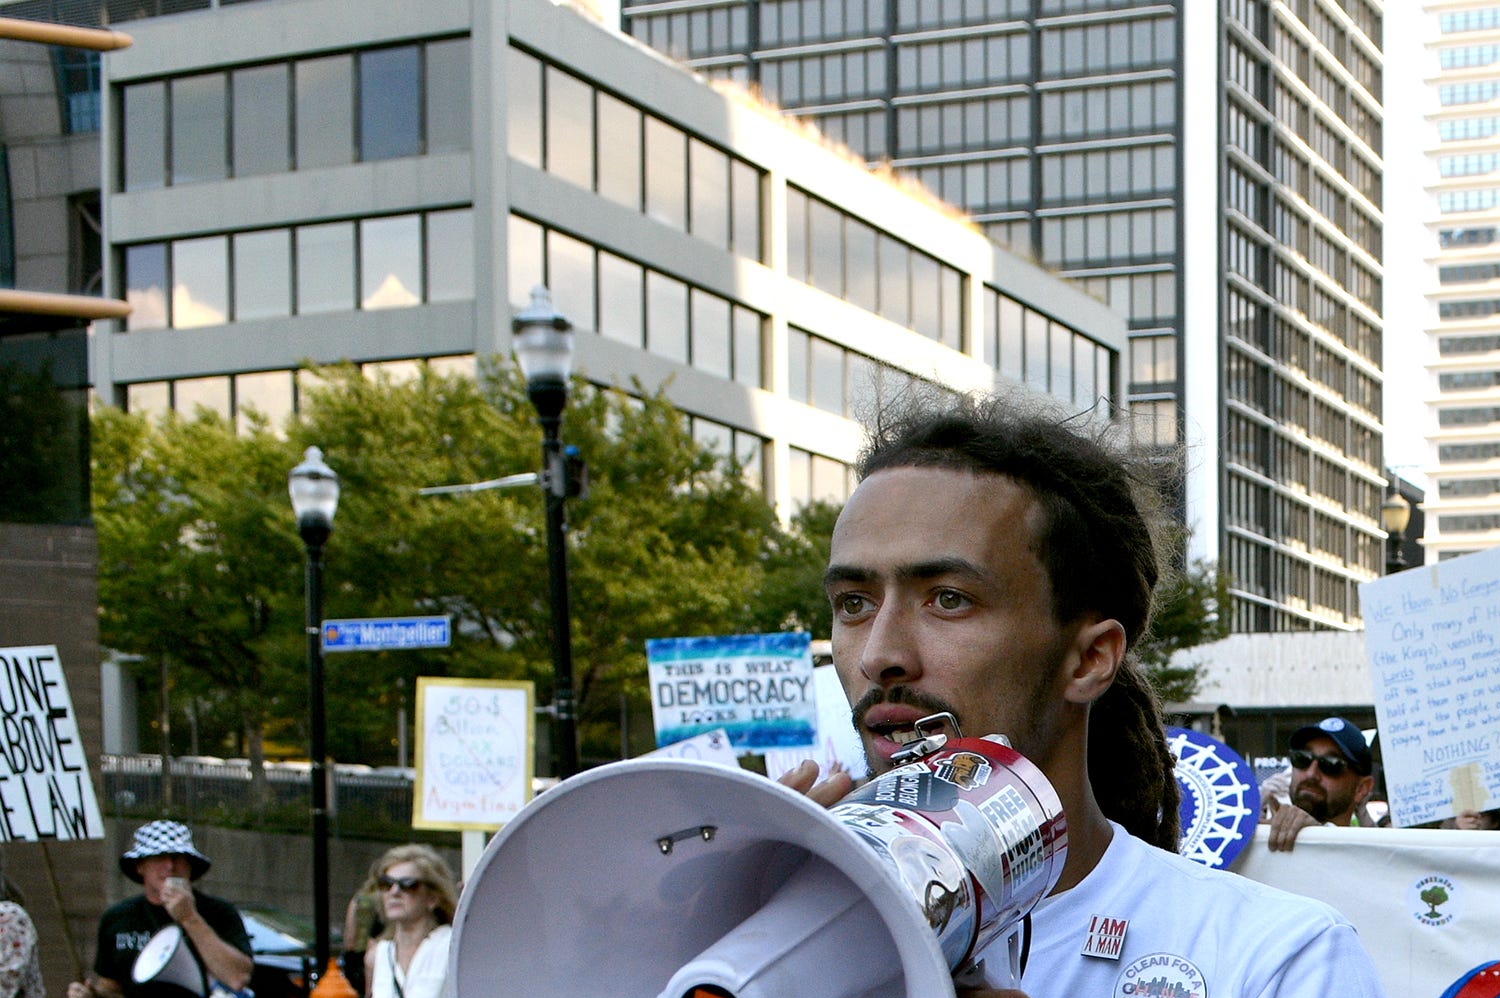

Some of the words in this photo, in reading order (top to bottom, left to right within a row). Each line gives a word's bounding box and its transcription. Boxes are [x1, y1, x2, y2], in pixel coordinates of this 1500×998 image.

[1391, 621, 1424, 642] Only
[664, 664, 704, 677] THIS
[715, 662, 732, 675] IS
[745, 659, 793, 674] WHAT
[657, 675, 811, 708] DEMOCRACY
[752, 708, 793, 721] LIKE
[21, 775, 89, 840] LAW
[981, 788, 1027, 829] FREE
[1012, 845, 1045, 891] HUGS
[1089, 916, 1098, 933] I
[1098, 918, 1127, 937] AM
[1084, 935, 1093, 952] A
[1095, 935, 1121, 956] MAN
[1125, 956, 1170, 980] CLEAN
[1171, 959, 1197, 980] FOR
[1191, 979, 1203, 991] A
